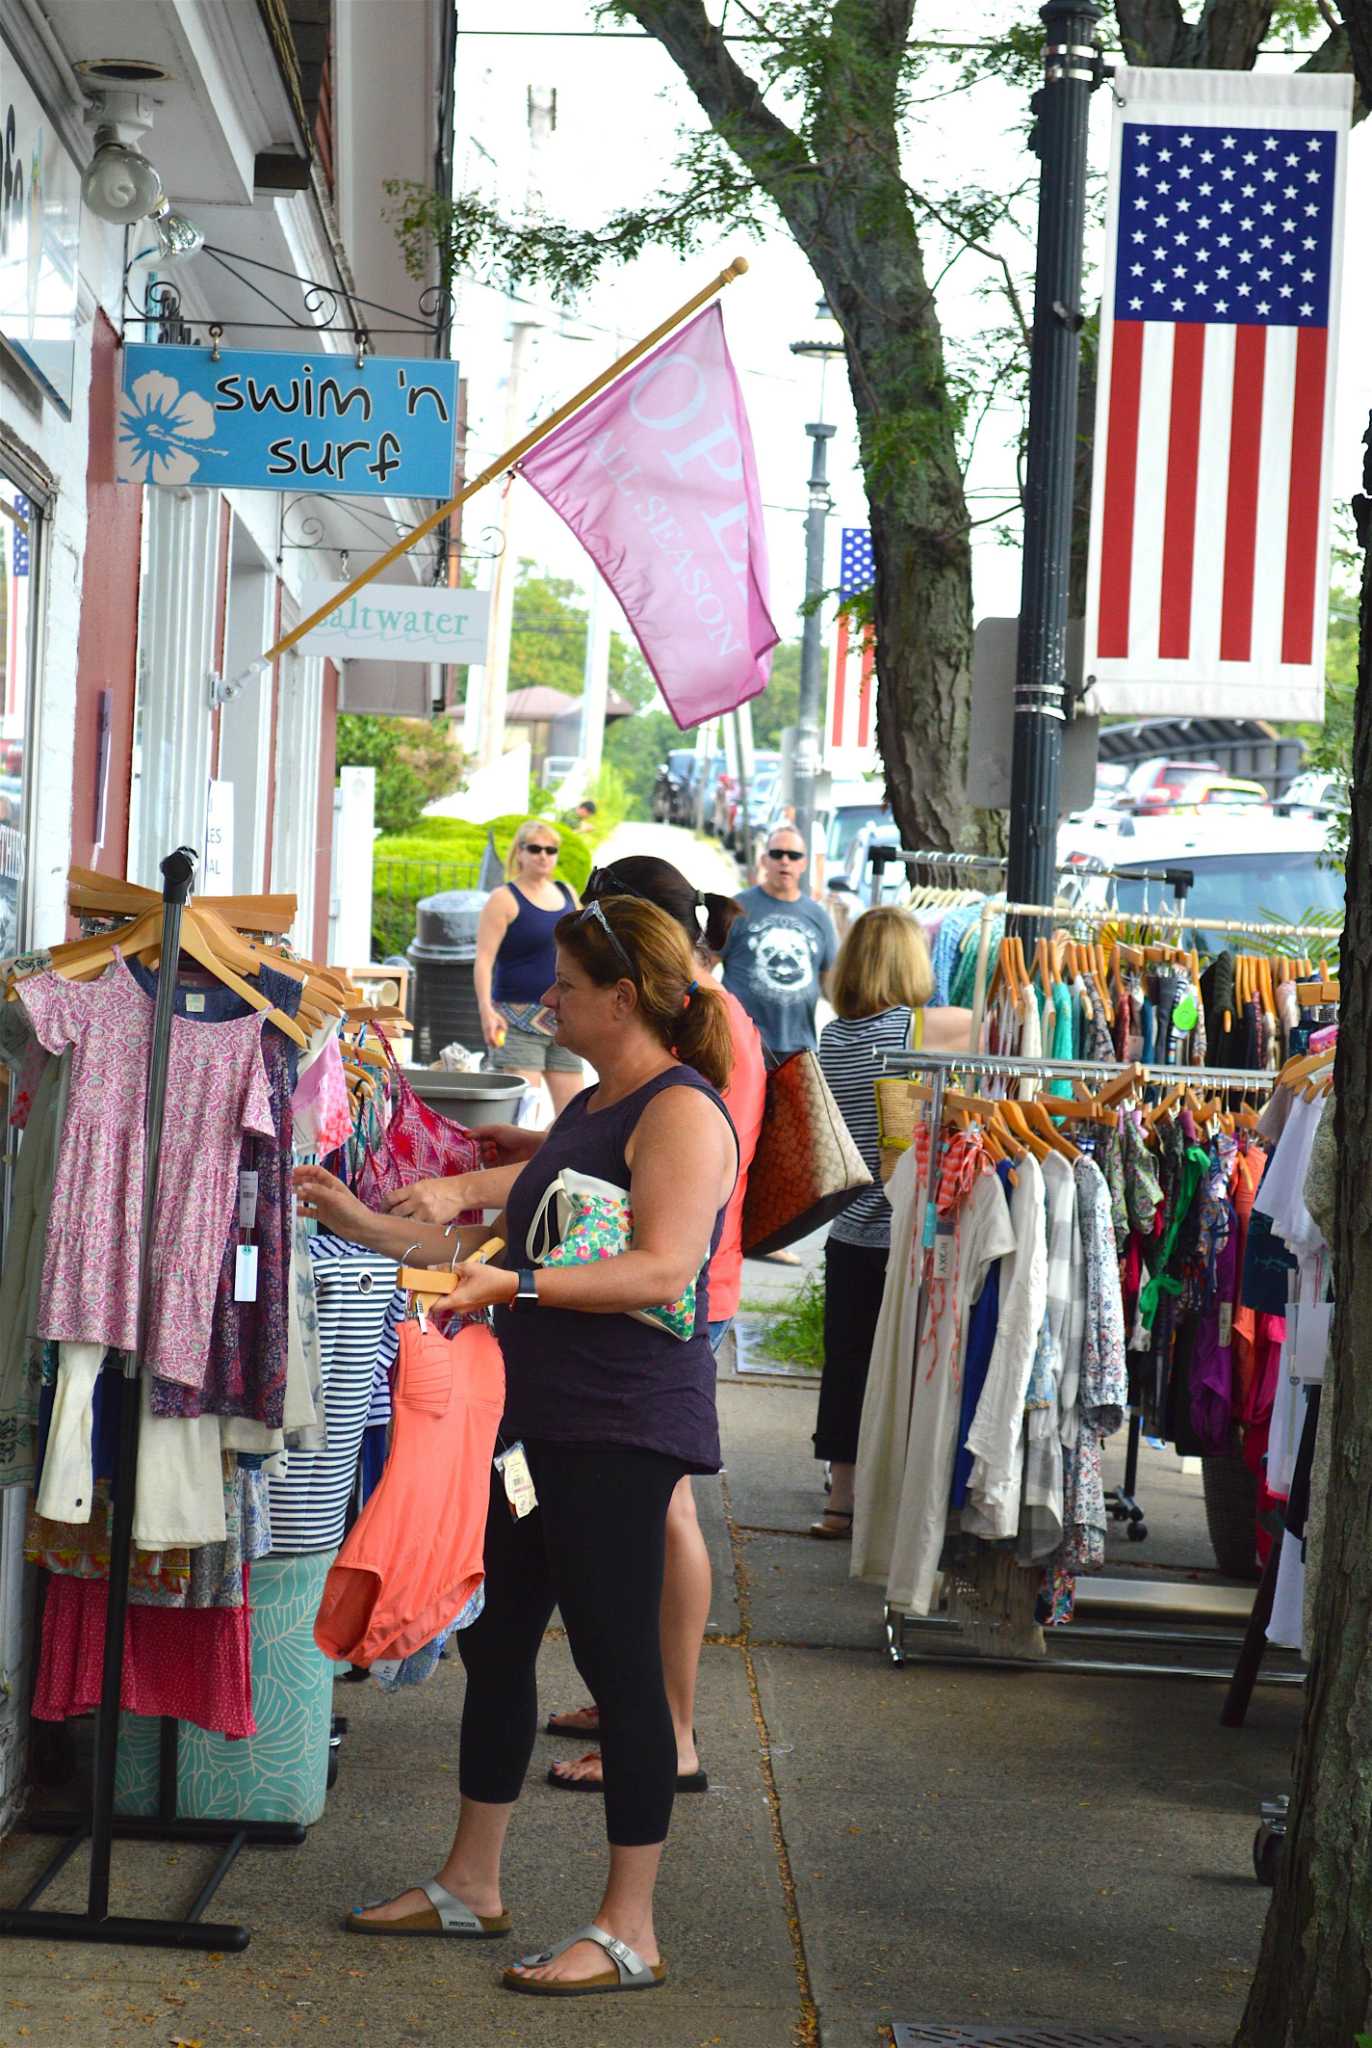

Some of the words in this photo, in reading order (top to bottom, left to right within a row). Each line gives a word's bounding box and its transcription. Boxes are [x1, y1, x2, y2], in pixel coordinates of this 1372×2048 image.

[214, 365, 372, 422] swim
[397, 368, 449, 423] 'n
[268, 431, 401, 482] surf
[629, 353, 749, 607] OPE
[632, 495, 745, 657] SEASON
